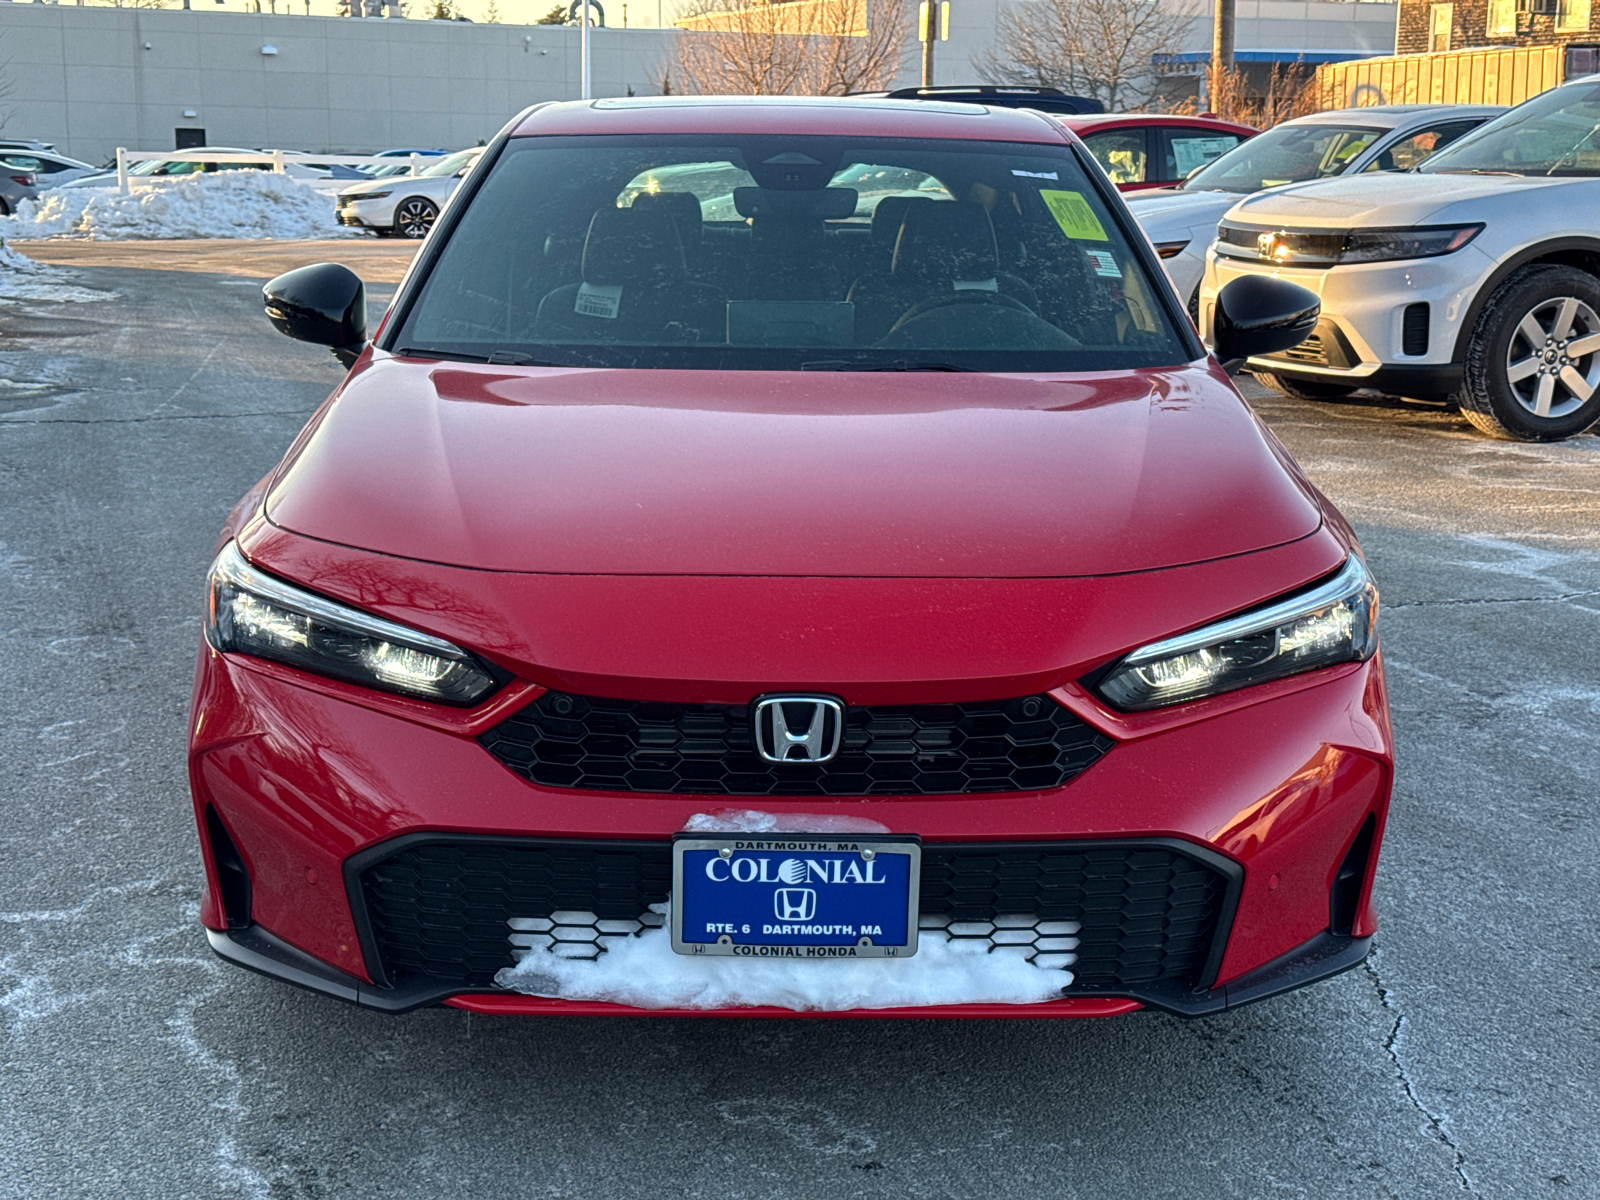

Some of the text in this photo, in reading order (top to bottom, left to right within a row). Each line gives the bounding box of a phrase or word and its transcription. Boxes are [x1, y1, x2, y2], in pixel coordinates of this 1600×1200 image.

[735, 841, 859, 850] DARTMOUTH, MA
[705, 857, 886, 884] COLONIAL
[706, 923, 882, 936] RTE. 6 DARTMOUTH, MA
[732, 945, 857, 957] COLONIAL HONDA
